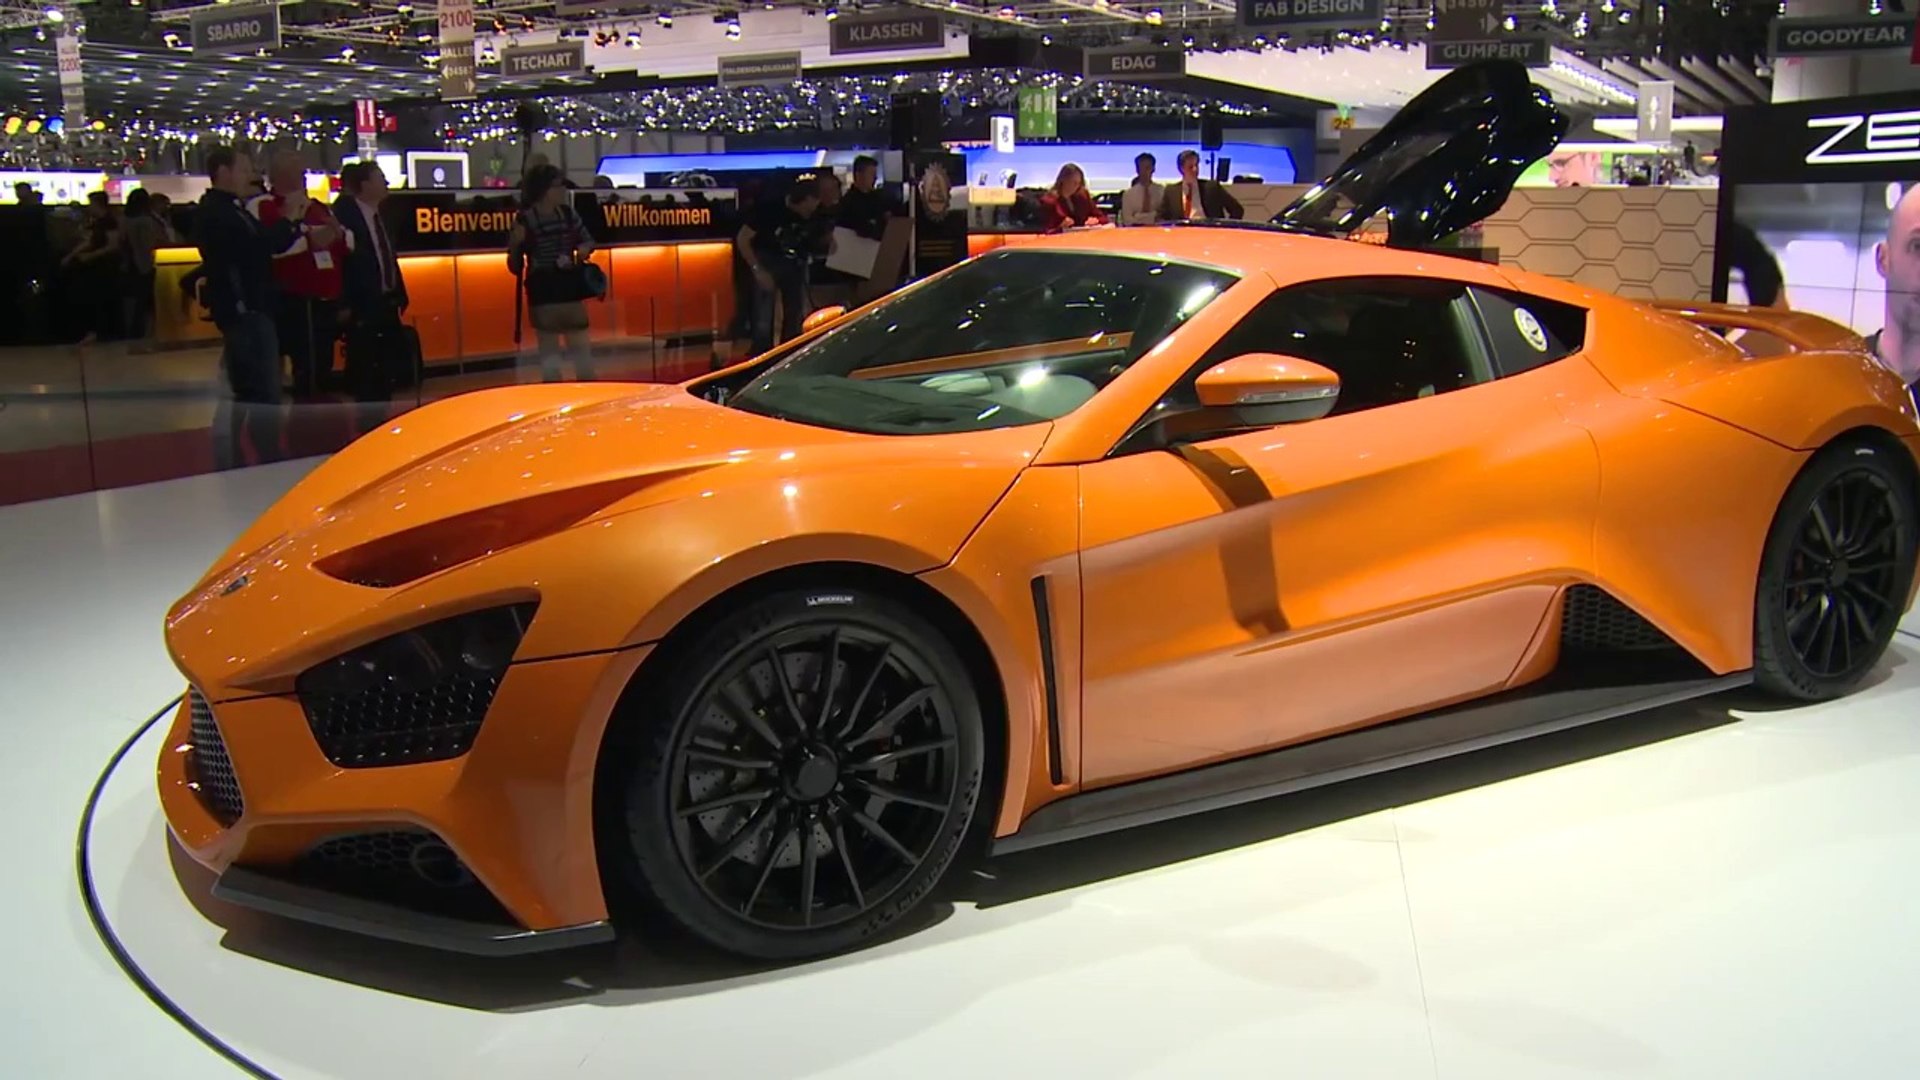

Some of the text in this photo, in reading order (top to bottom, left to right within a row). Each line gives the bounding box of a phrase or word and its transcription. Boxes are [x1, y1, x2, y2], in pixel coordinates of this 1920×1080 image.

[1254, 0, 1365, 17] FAB DESIGN
[441, 10, 472, 28] 2100
[207, 21, 261, 41] SBARRO
[849, 21, 924, 42] KLASSEN
[1786, 25, 1907, 46] GOODYEAR
[1443, 43, 1534, 60] GUMPERT
[512, 52, 573, 72] TECHART
[1111, 55, 1157, 71] EDAG
[604, 204, 711, 228] Willkommen
